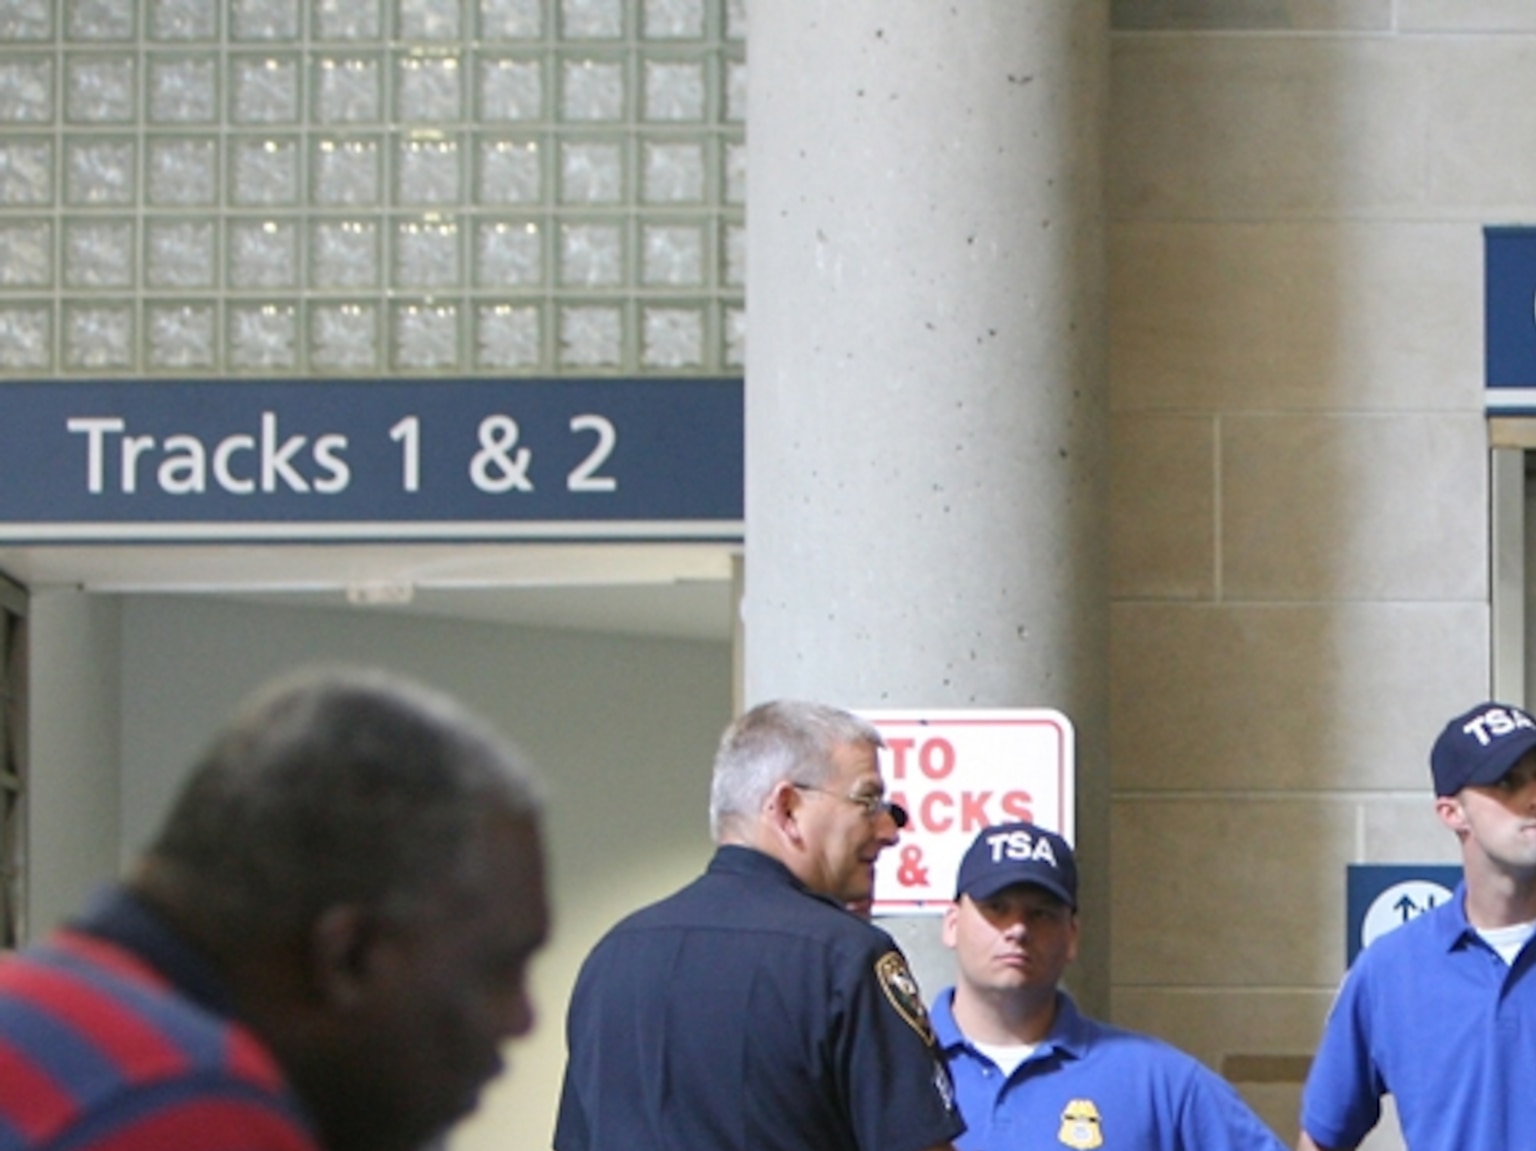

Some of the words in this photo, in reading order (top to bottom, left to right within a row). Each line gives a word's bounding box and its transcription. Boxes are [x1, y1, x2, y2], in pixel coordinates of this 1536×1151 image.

[67, 412, 351, 494] Tracks
[389, 416, 422, 493] 1
[469, 415, 535, 493] &
[566, 415, 618, 493] 2
[1463, 708, 1536, 746] TSA
[886, 737, 956, 781] TO
[888, 790, 1034, 834] ACKS
[896, 844, 929, 888] &
[987, 831, 1057, 868] TSA
